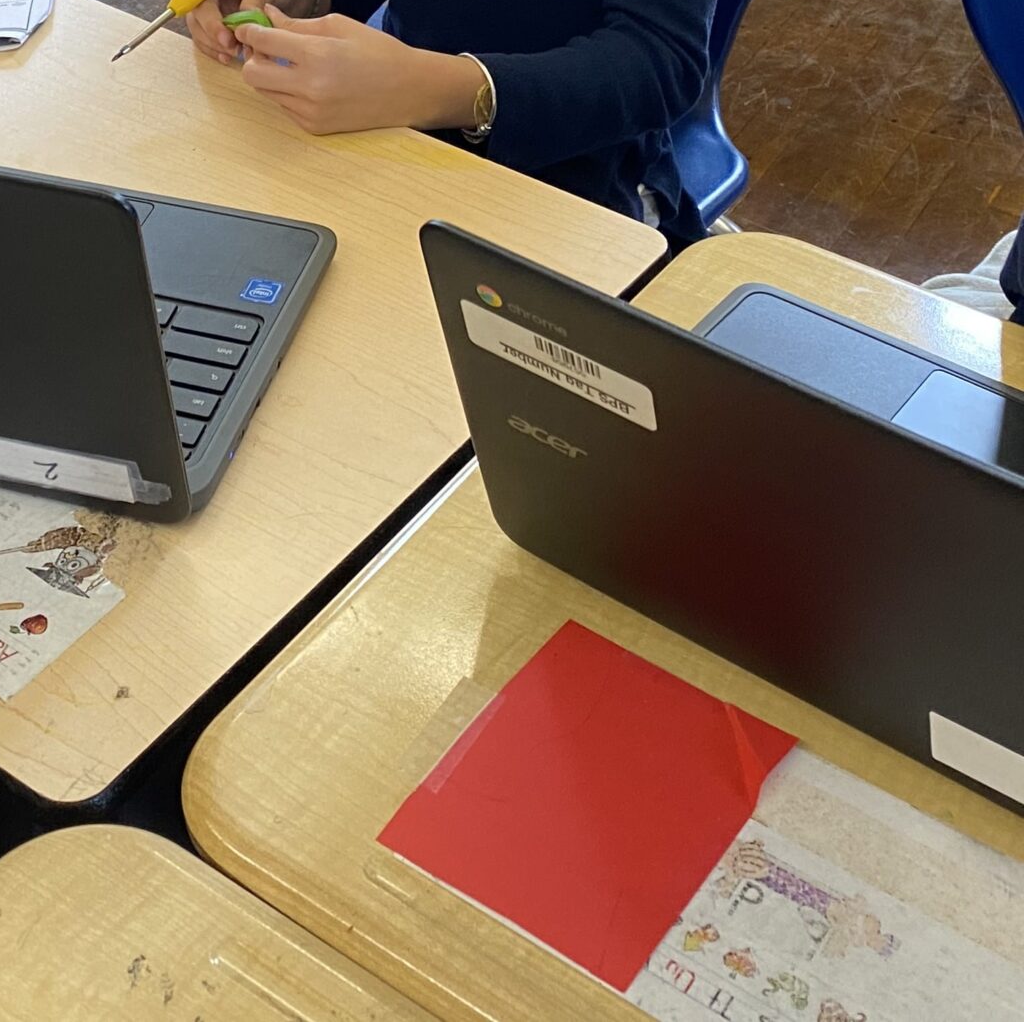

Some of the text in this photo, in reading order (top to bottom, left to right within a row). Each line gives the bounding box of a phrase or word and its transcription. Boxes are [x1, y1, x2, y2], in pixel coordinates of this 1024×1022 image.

[502, 344, 562, 382] Number
[564, 373, 595, 399] Tag
[598, 390, 630, 416] BPS
[507, 414, 588, 459] acer
